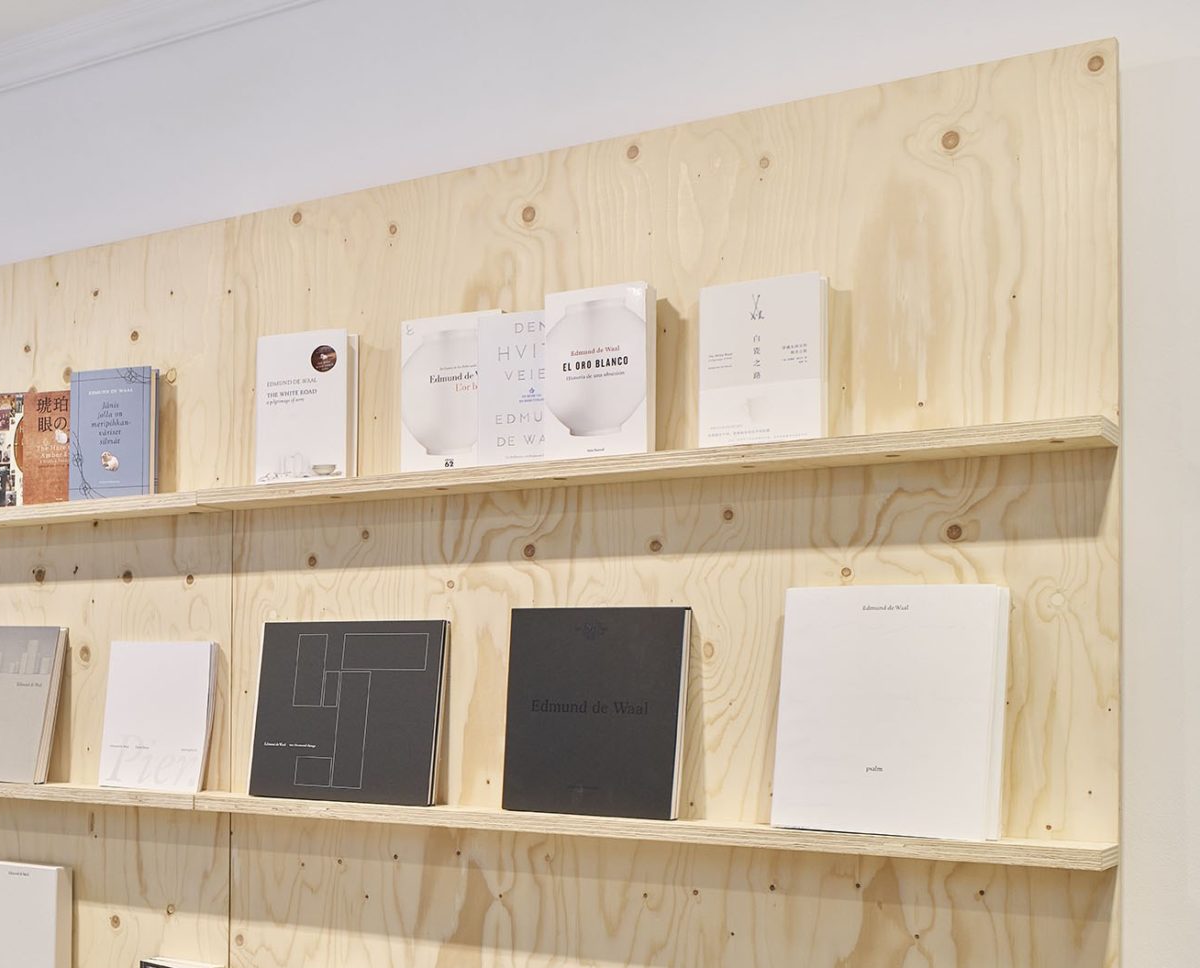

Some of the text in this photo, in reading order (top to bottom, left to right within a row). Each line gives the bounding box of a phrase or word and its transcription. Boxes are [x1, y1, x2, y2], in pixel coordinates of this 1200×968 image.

[514, 321, 545, 334] DEN
[498, 342, 545, 362] HVI
[570, 347, 595, 357] Edmund
[605, 345, 620, 353] Waal
[563, 355, 629, 372] EL ORO BLANCO
[266, 379, 292, 388] EDMUND
[429, 371, 473, 384] Edmund de
[267, 388, 318, 399] THE WHITE ROAD
[497, 435, 515, 447] DE
[862, 604, 909, 612] Edmund de Waal
[531, 699, 649, 716] Edmund de Waal
[865, 765, 883, 773] psalm
